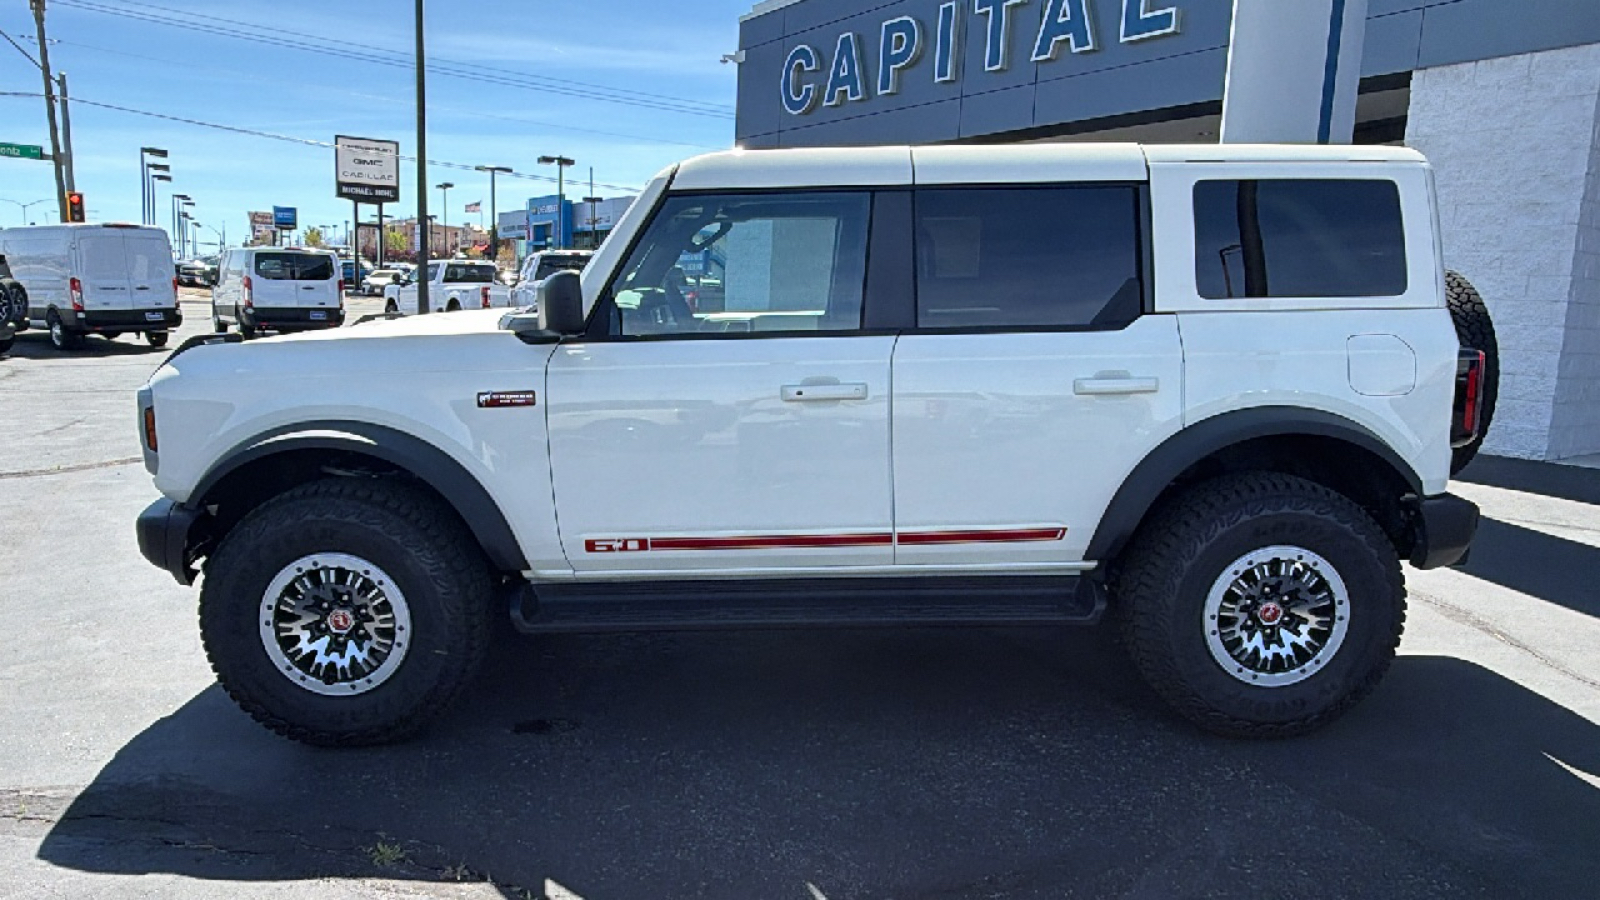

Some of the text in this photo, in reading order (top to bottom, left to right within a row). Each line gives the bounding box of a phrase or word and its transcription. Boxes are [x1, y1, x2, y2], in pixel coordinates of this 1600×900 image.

[780, 0, 1181, 115] CAPITAL
[353, 158, 383, 167] GMC
[342, 170, 394, 181] CADILLAC
[342, 186, 373, 196] MICHAEL
